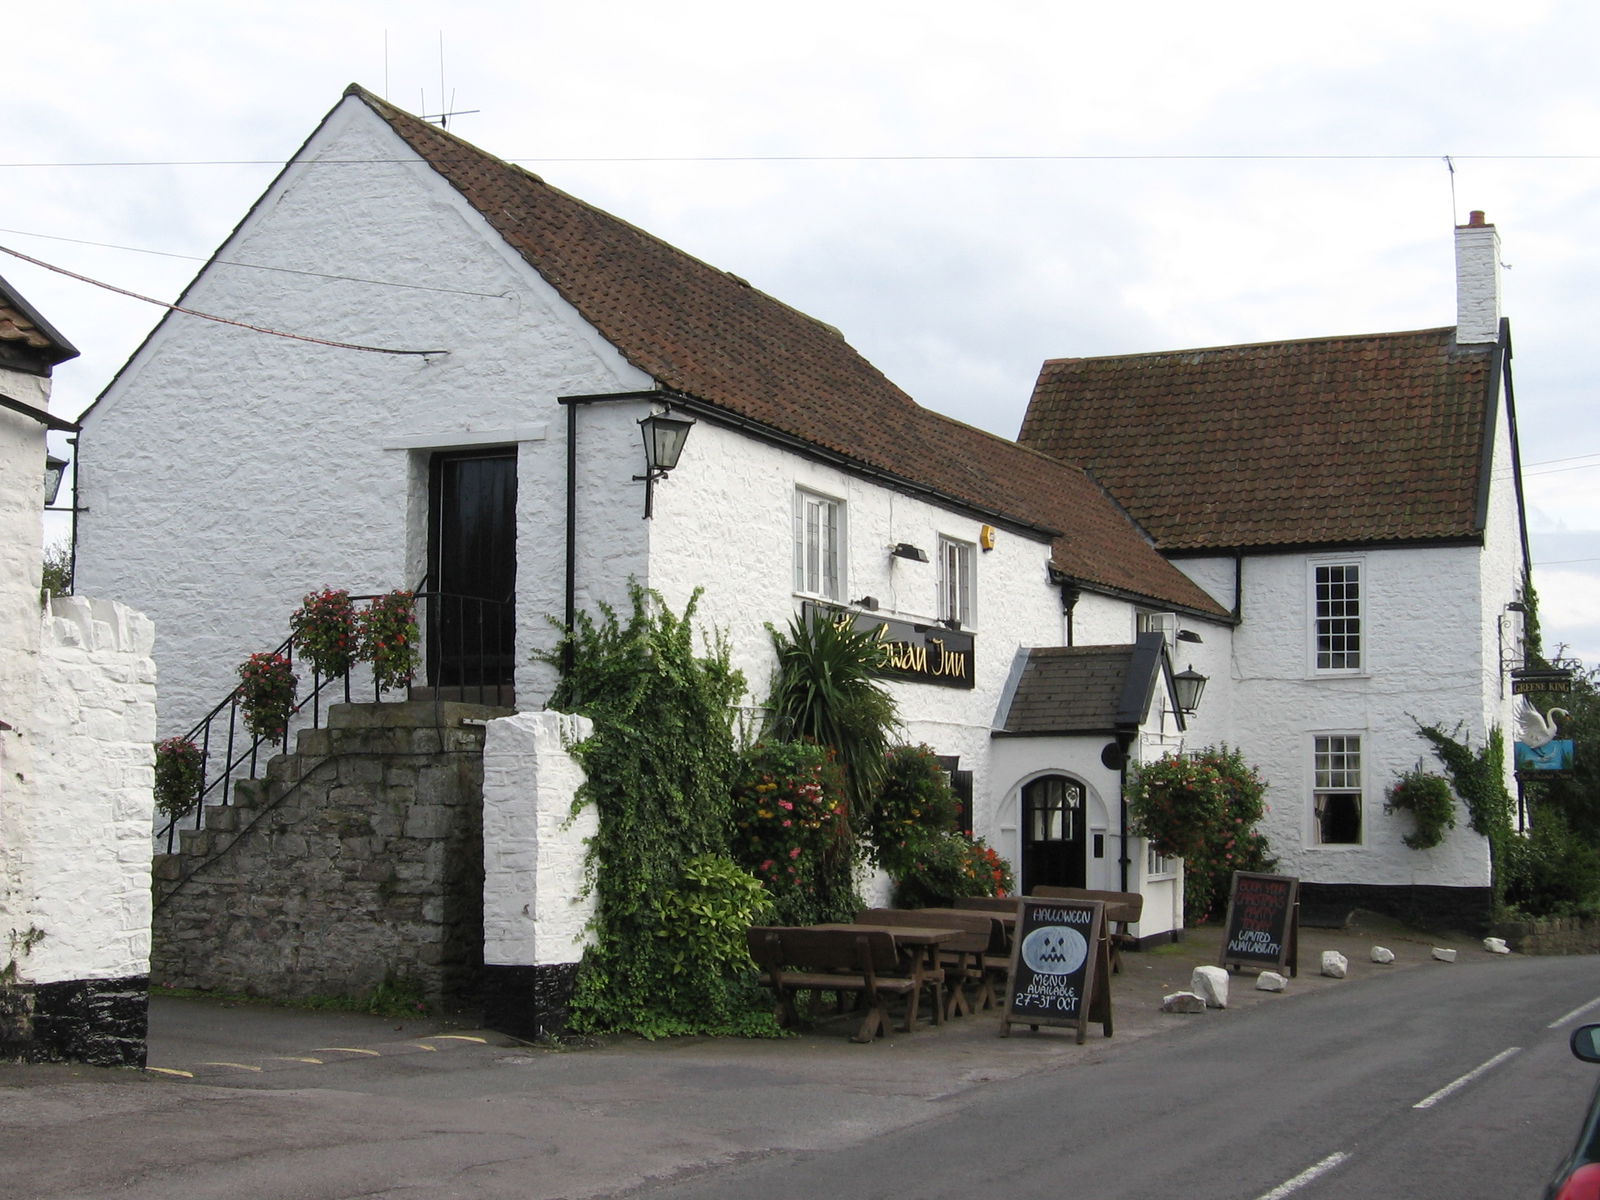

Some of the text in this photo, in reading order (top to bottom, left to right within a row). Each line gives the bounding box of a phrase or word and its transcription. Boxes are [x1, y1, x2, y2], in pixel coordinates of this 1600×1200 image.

[931, 637, 966, 679] Inn
[1514, 682, 1569, 693] GREENE KING
[1033, 908, 1091, 924] HALLOWEEN
[1238, 930, 1271, 943] LIMITED
[1228, 939, 1281, 955] AVAILABILITY
[1032, 974, 1067, 987] MENU
[1027, 984, 1075, 997] AVAILABLE
[1057, 996, 1079, 1011] OCT
